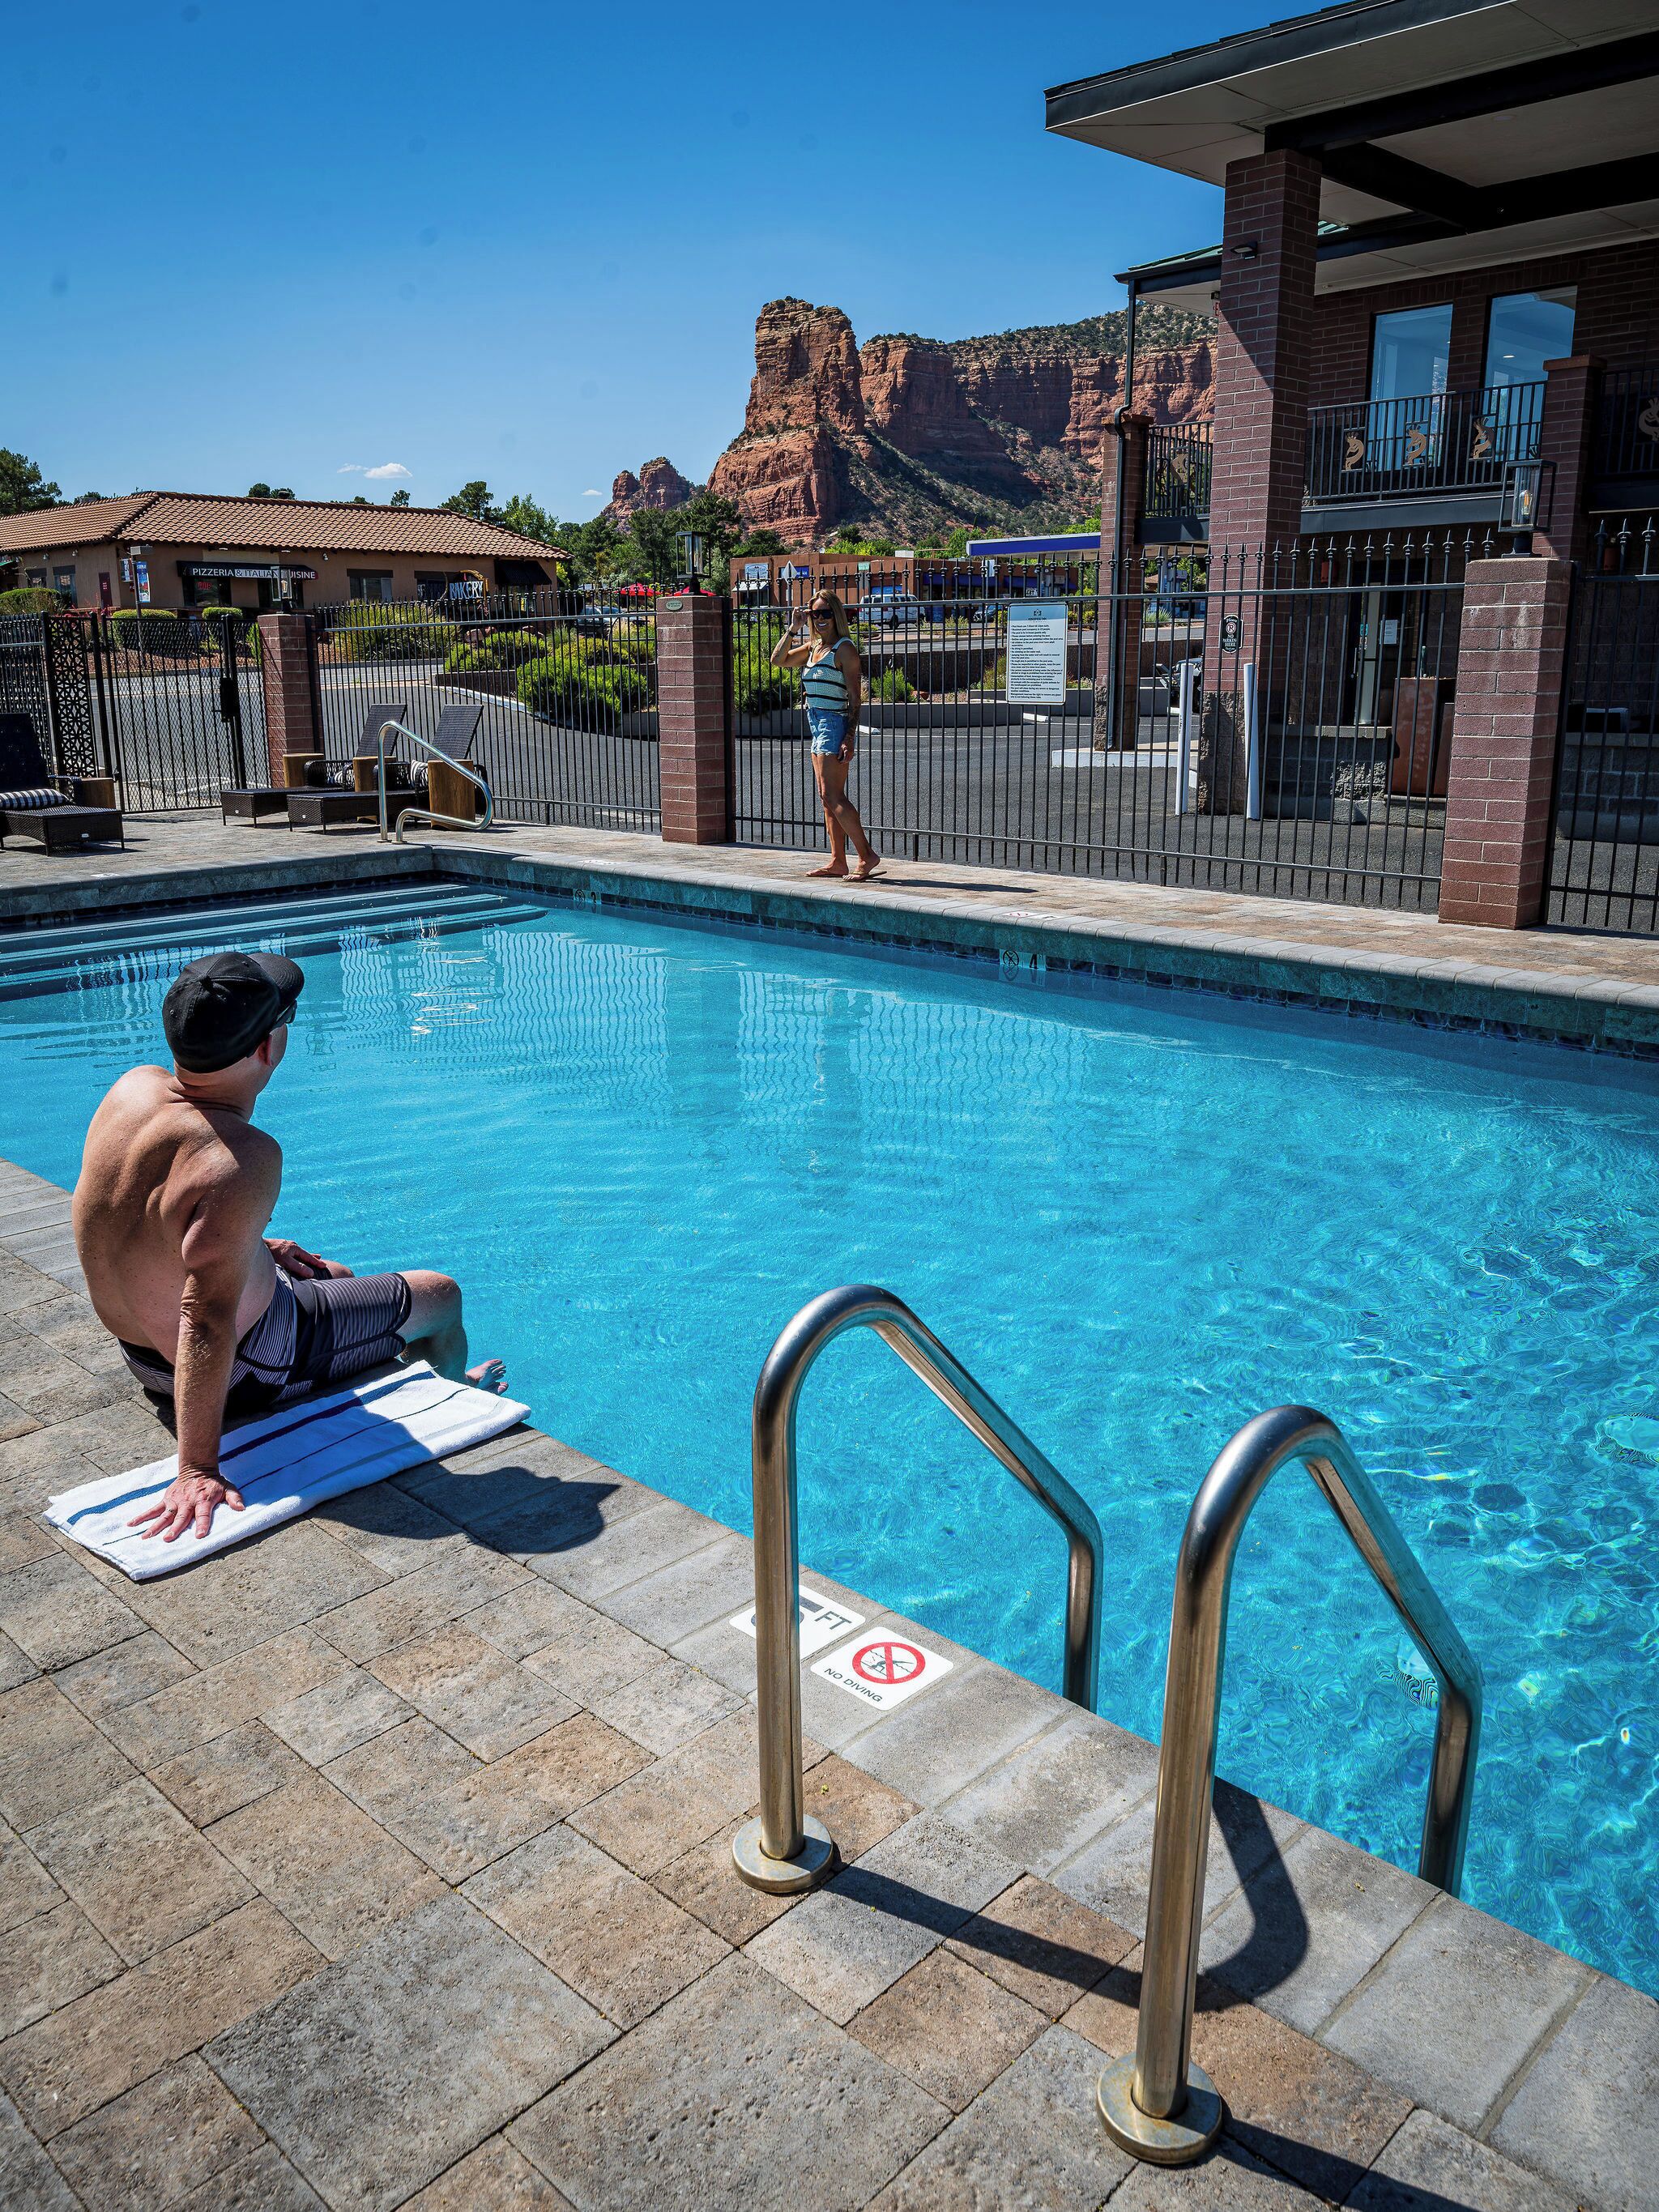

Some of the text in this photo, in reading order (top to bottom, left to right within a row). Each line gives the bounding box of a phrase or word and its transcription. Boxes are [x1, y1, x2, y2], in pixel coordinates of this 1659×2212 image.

[193, 568, 234, 577] PIZZERIA
[288, 571, 315, 579] UISINE
[449, 582, 484, 599] BAKERY
[1029, 953, 1038, 970] 4
[814, 1610, 852, 1630] FT
[824, 1668, 883, 1702] NO DIVING
